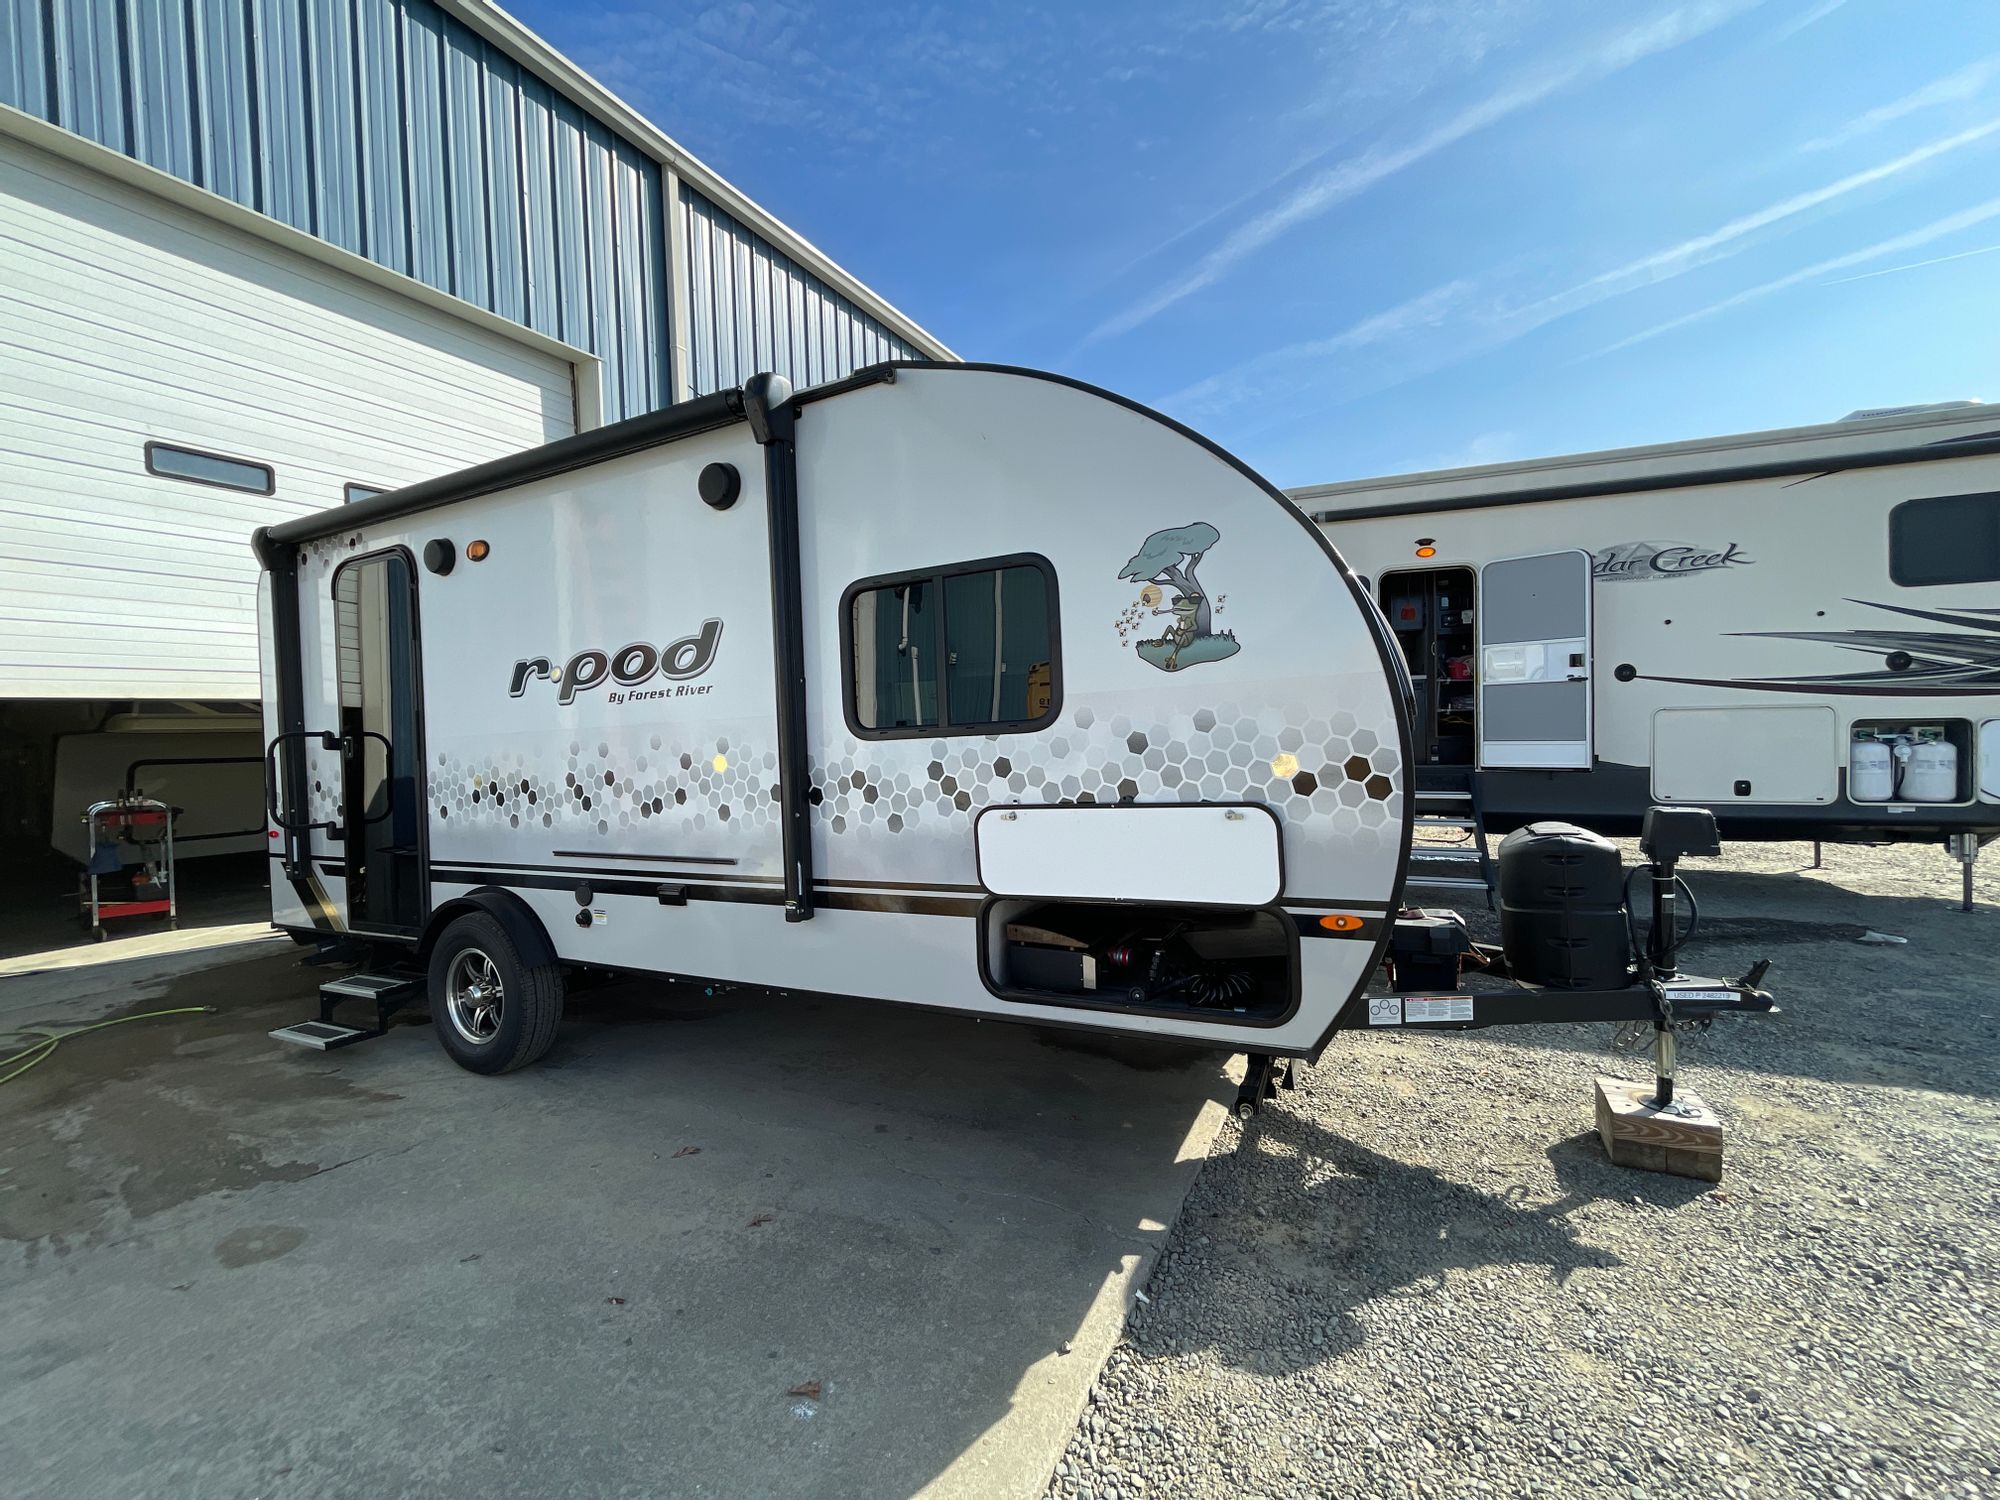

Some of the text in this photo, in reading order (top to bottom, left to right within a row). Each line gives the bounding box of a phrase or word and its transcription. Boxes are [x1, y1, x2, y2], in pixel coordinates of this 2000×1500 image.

[1593, 542, 1756, 574] dar Creek
[608, 685, 713, 705] By Forest River
